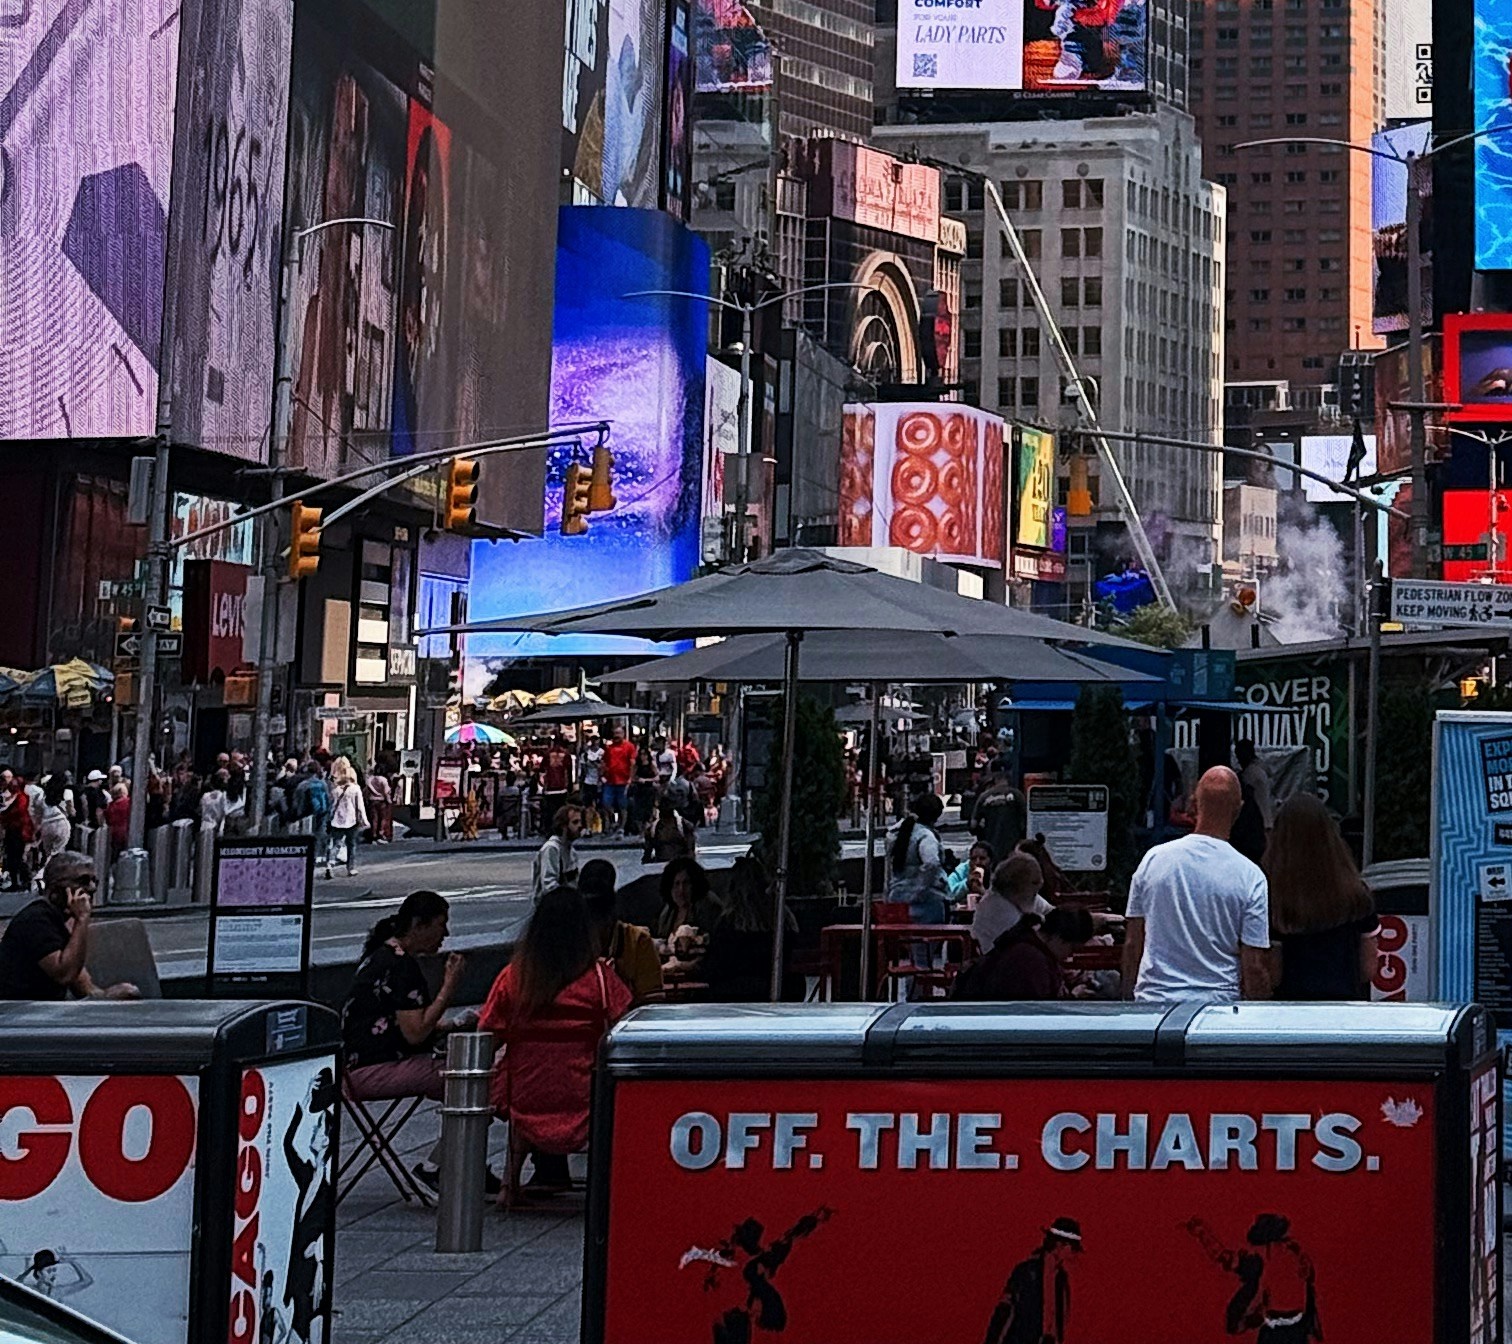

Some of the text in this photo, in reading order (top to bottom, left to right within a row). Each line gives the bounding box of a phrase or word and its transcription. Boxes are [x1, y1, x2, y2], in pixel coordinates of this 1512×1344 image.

[914, 25, 1007, 44] LADY PARTS
[1396, 588, 1462, 602] PEDESTRIAN
[1464, 590, 1493, 603] FLOW
[1396, 604, 1467, 618] KEEP MOVING
[1488, 775, 1504, 792] IN
[669, 1110, 1382, 1173] OFF. THE. CHARTS.
